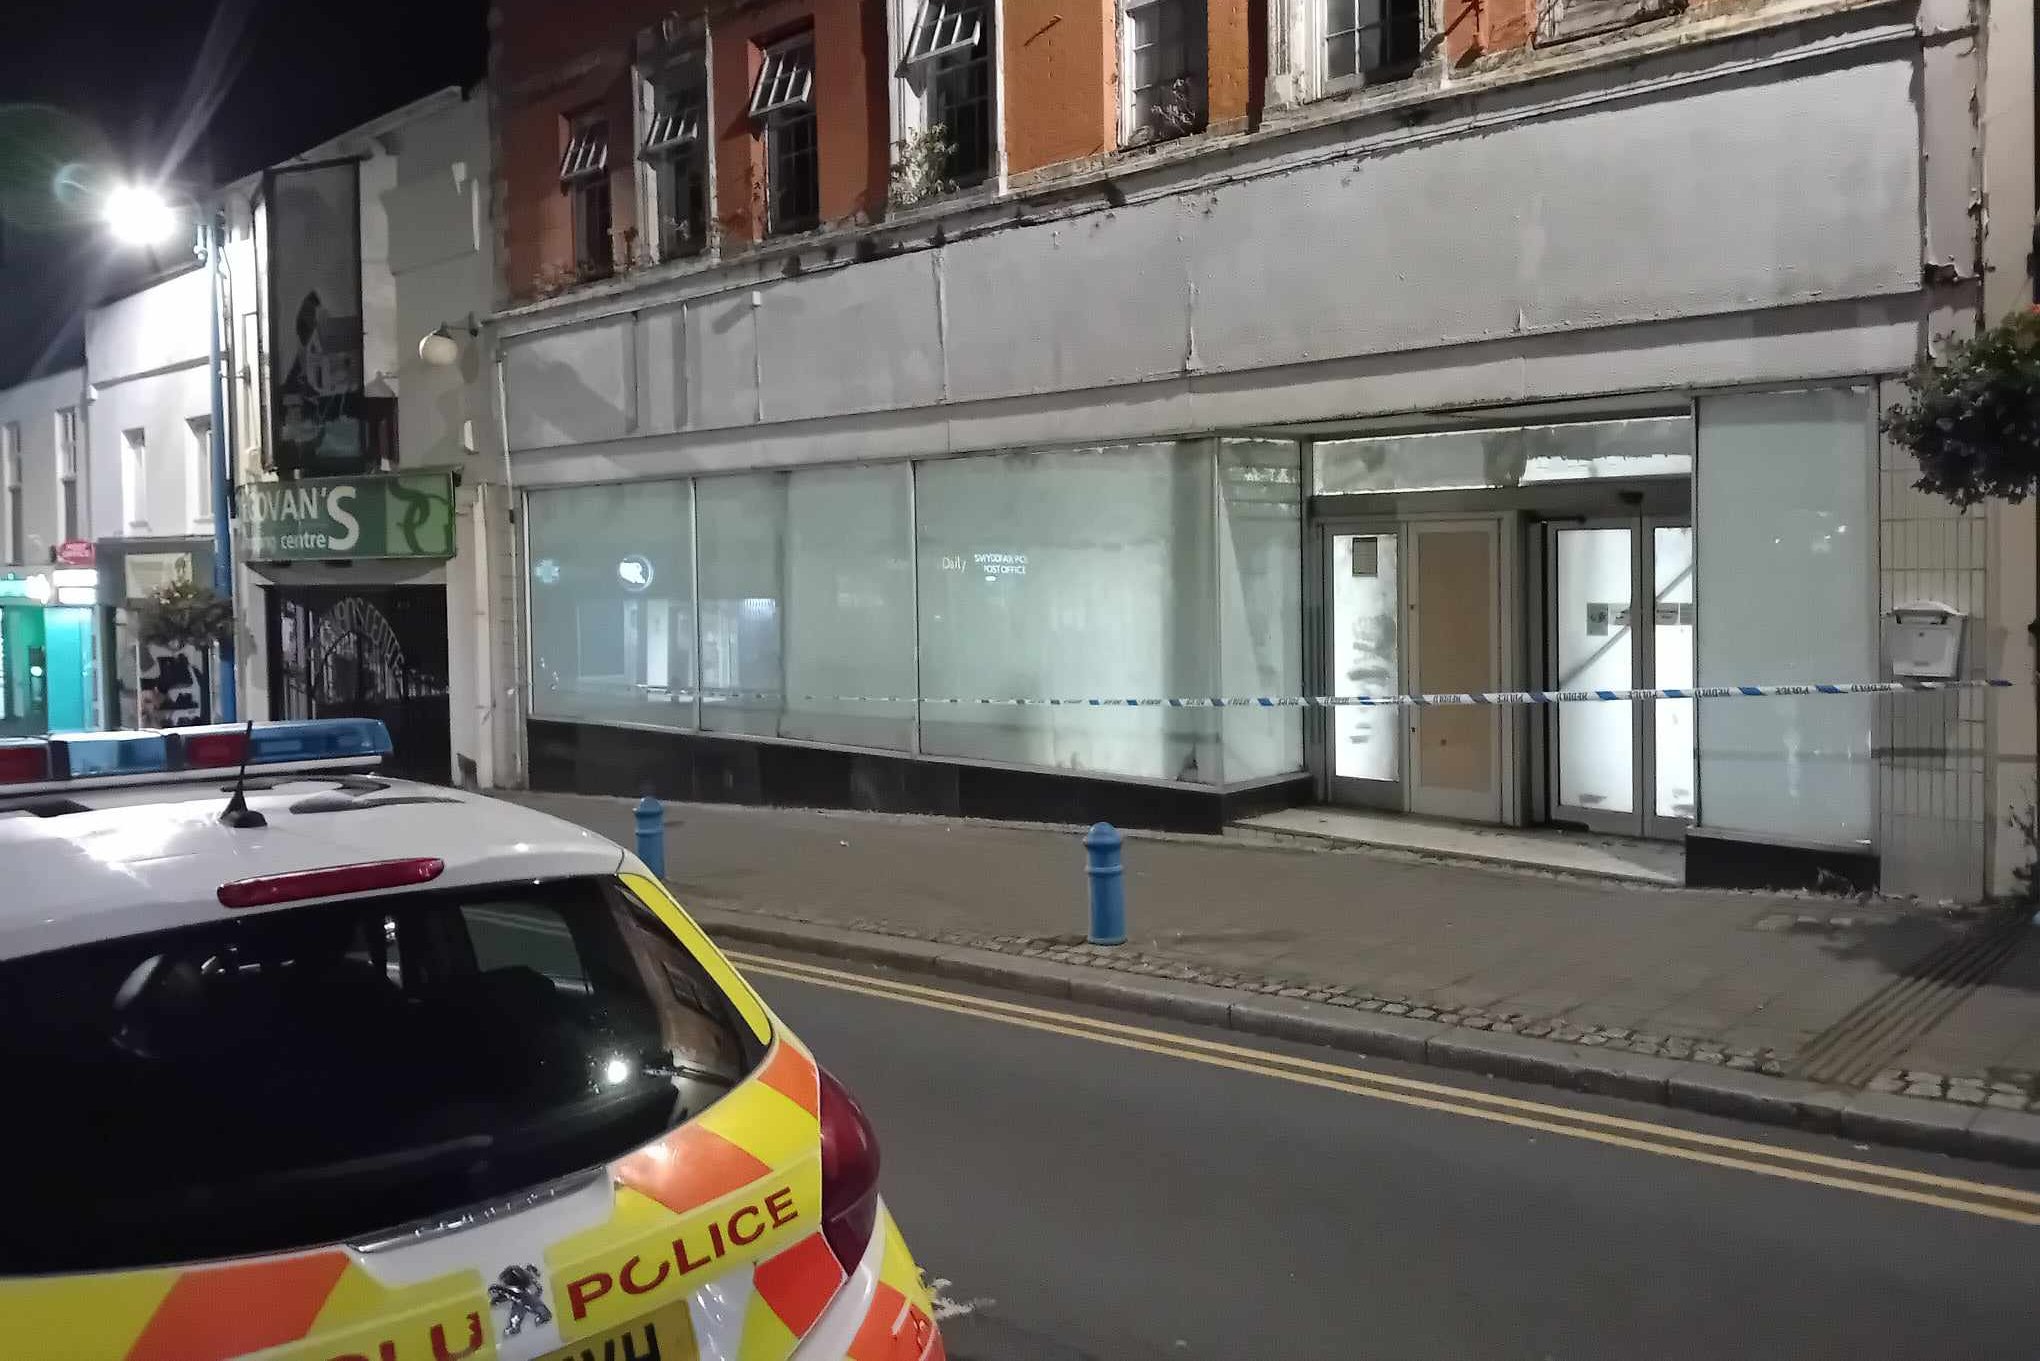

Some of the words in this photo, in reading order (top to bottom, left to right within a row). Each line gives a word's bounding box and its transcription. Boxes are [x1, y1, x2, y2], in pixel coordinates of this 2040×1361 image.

[240, 486, 359, 550] OVAN'S
[281, 532, 327, 549] centre
[567, 1187, 799, 1321] POLICE
